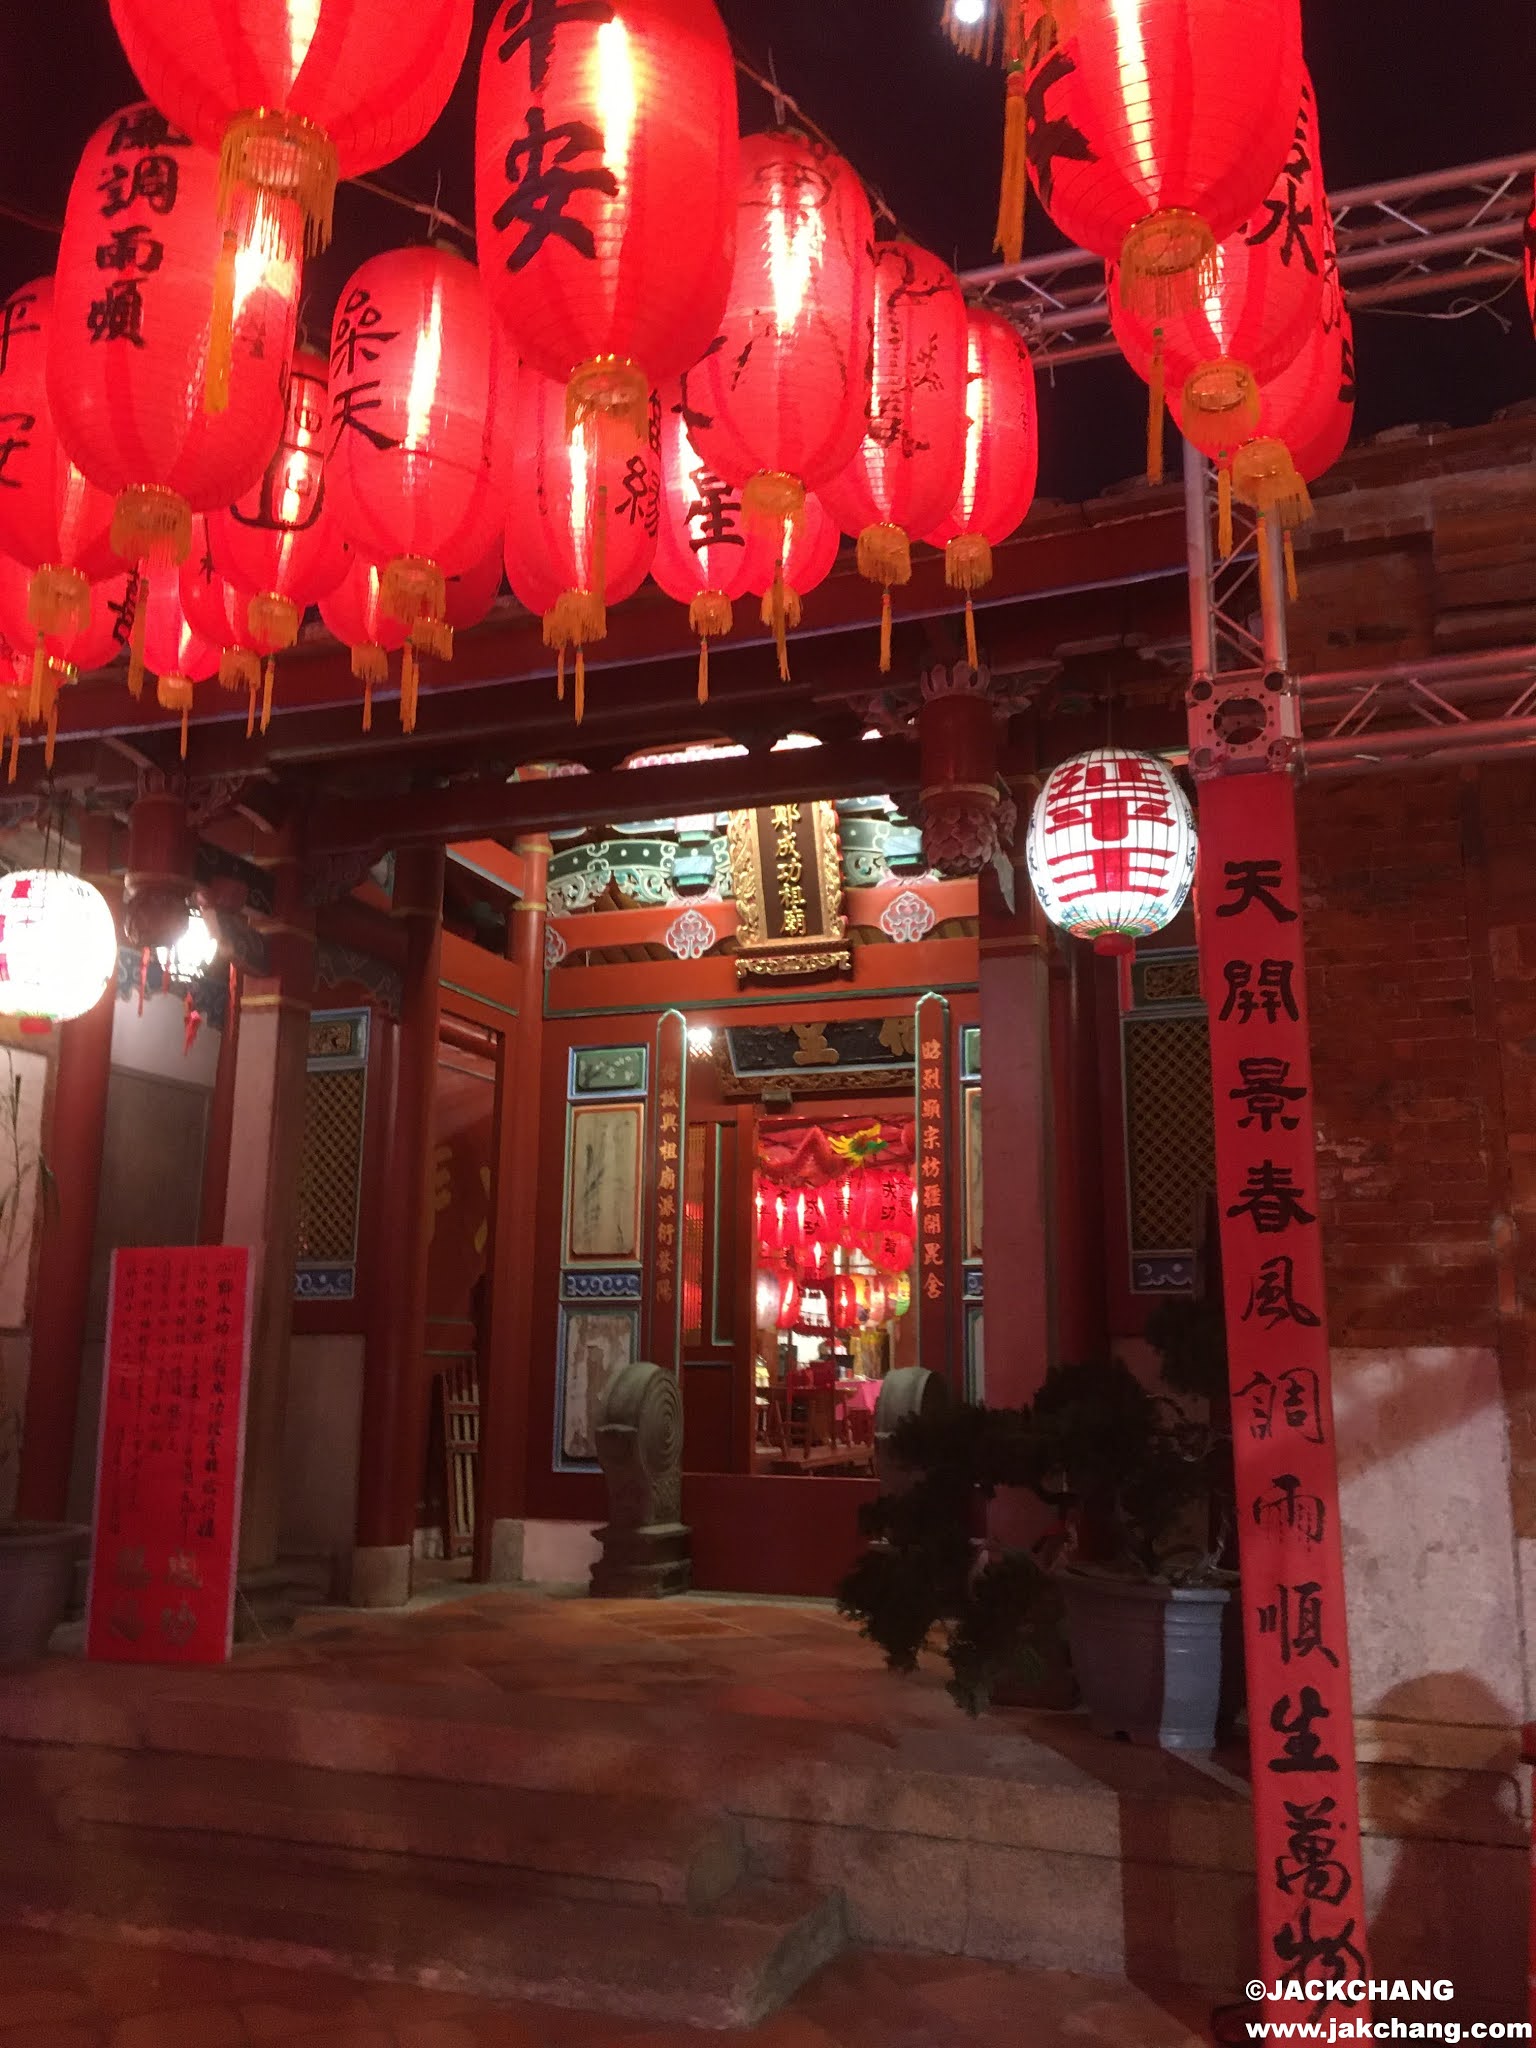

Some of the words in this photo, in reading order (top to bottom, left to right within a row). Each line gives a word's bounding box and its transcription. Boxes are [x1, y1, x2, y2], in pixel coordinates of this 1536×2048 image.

[770, 802, 808, 937] 鄭成功祖廟
